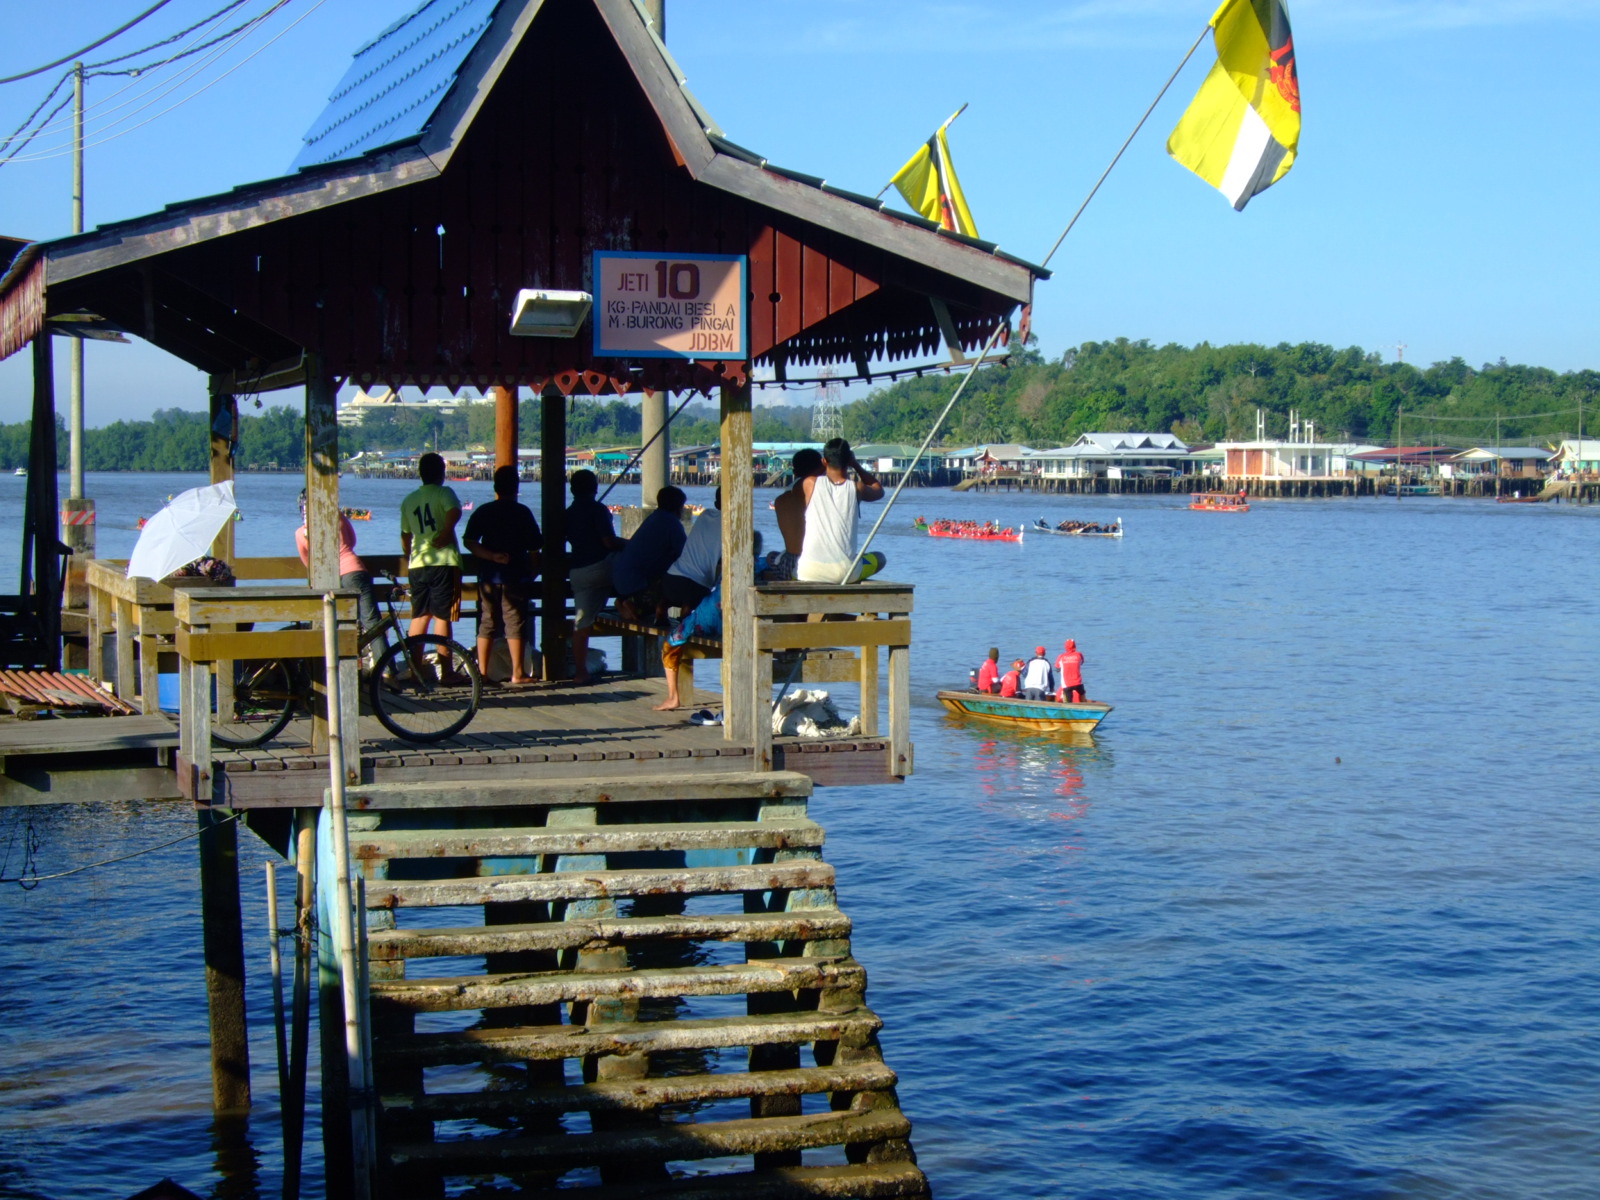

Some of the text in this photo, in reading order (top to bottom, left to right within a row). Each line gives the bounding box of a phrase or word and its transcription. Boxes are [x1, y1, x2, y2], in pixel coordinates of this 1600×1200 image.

[617, 260, 700, 299] JETI 10
[685, 302, 716, 316] BESI
[726, 303, 736, 316] A
[691, 316, 734, 331] PINGAI
[688, 332, 734, 351] JDBM
[413, 502, 437, 534] 14
